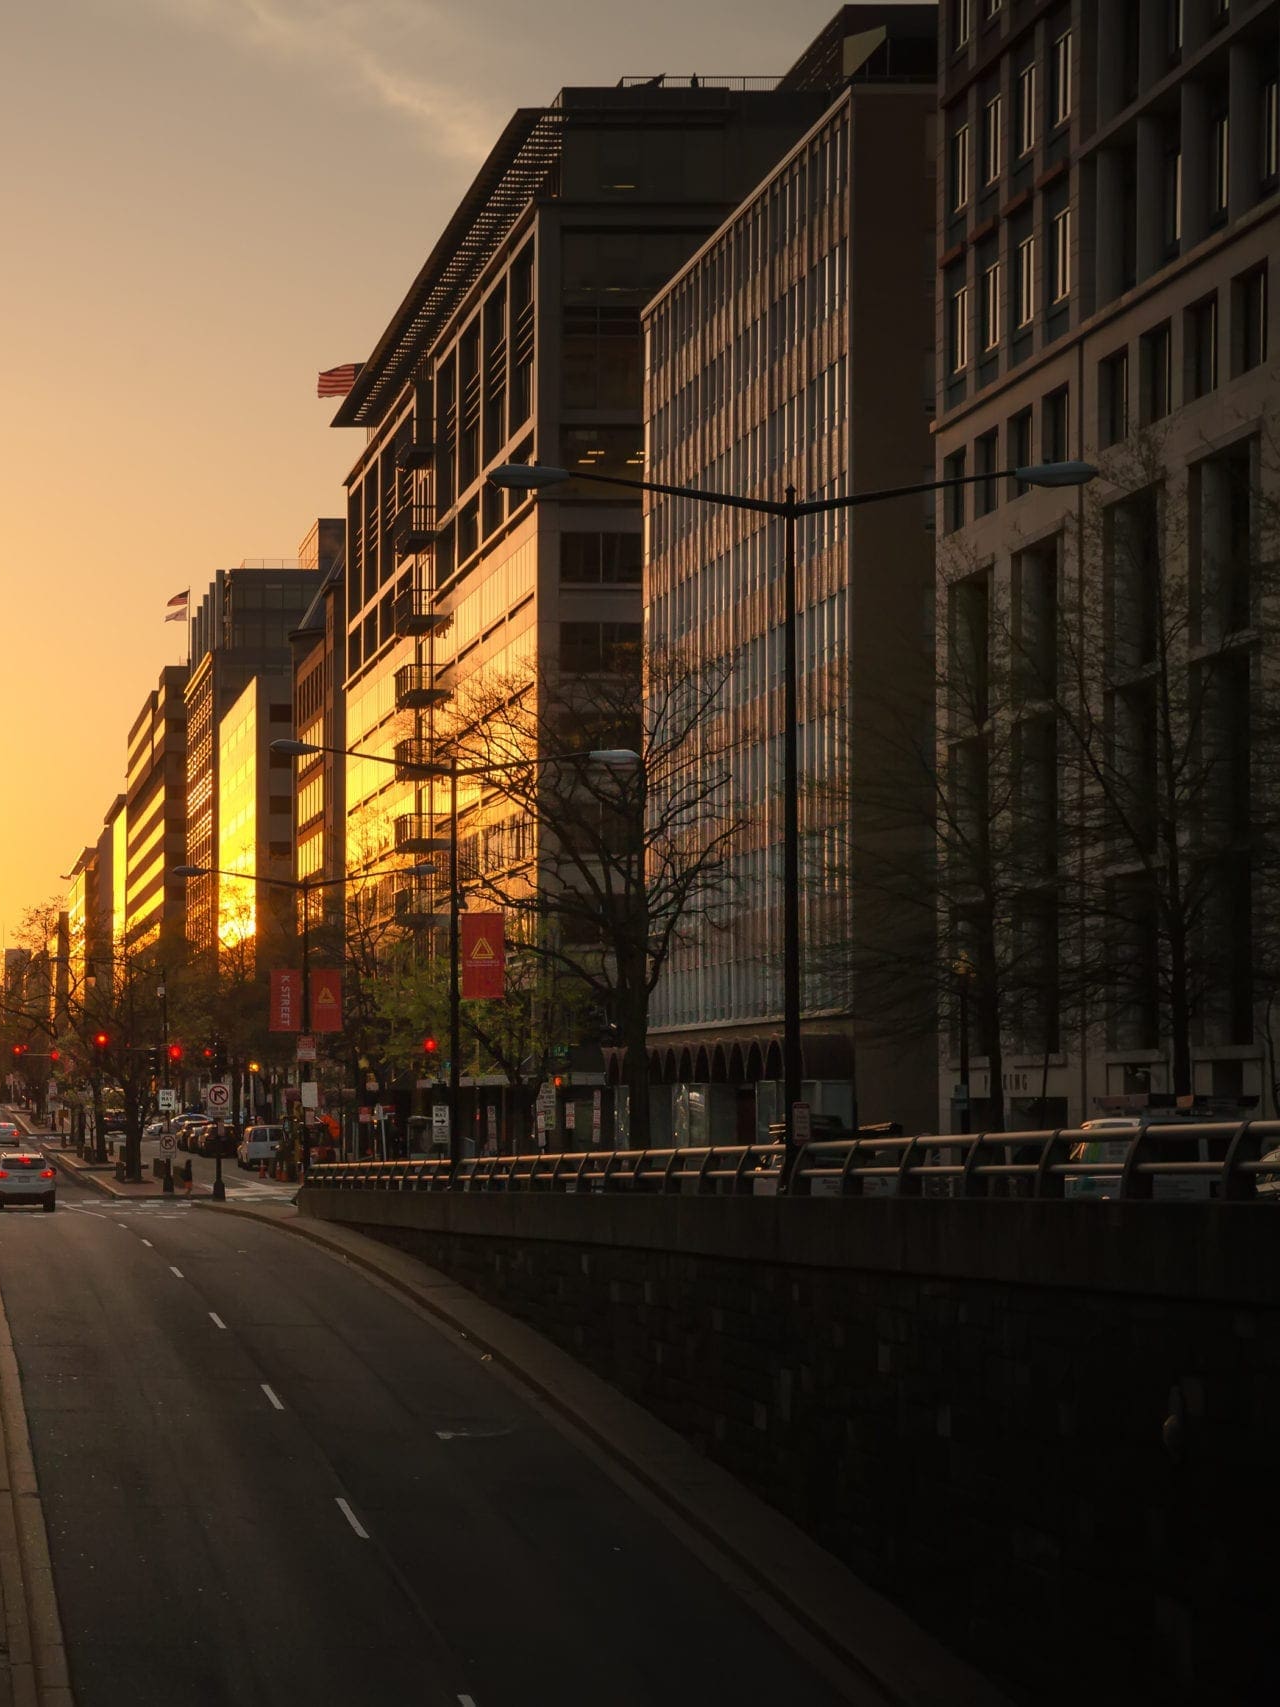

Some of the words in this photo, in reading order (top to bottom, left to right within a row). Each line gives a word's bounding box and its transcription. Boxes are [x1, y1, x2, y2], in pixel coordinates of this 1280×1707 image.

[281, 975, 290, 983] K
[281, 986, 290, 1026] STREET
[984, 1074, 1027, 1091] PKING
